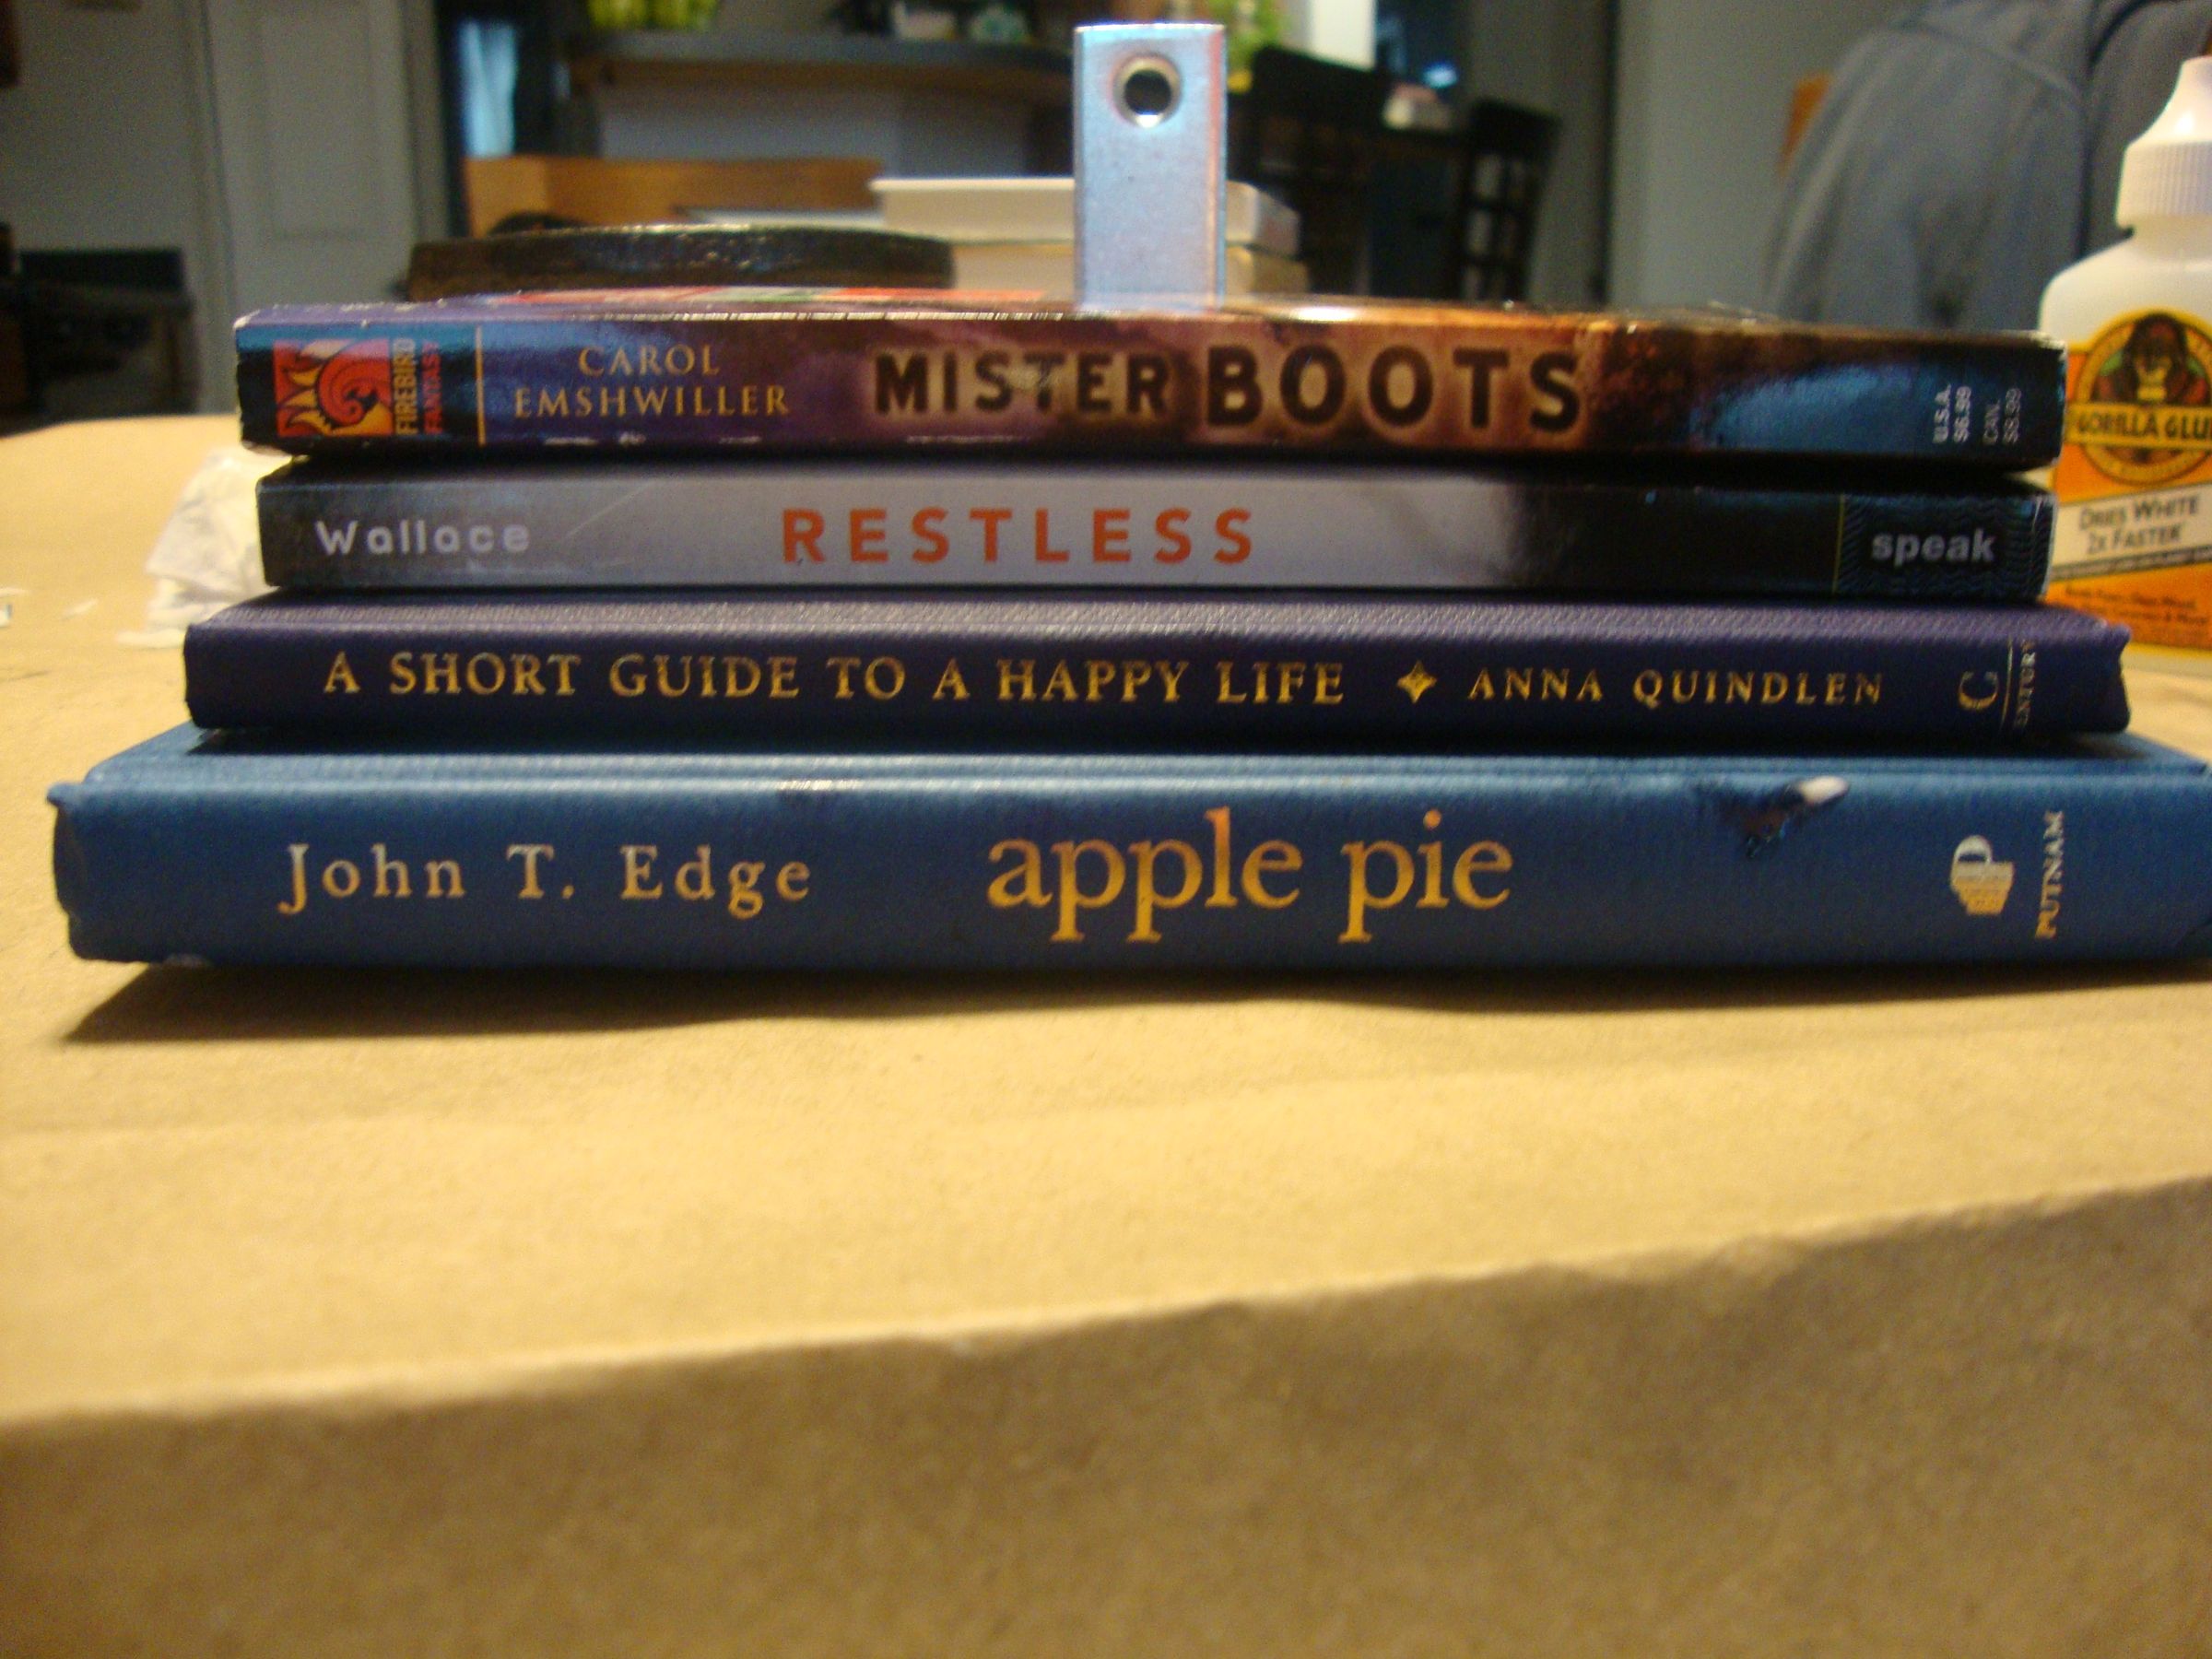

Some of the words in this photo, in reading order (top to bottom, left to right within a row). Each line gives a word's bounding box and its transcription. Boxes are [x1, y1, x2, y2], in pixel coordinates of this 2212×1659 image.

[393, 337, 417, 435] FIREBIRD
[579, 344, 719, 376] CAROL
[513, 385, 790, 418] EMSHWILLER
[875, 351, 1170, 415] MISTER
[1206, 344, 1580, 433] BOOTS
[316, 520, 531, 557] Wallace
[782, 507, 1253, 565] RESTLESS
[1870, 527, 1996, 569] speak
[324, 651, 360, 694] A
[388, 651, 582, 697] SHORT
[607, 653, 801, 700] GUIDE
[826, 655, 907, 700] TO
[931, 658, 971, 701] A
[995, 658, 1191, 704] HAPPY
[1215, 660, 1346, 706] LIFE
[1468, 666, 1604, 701] ANNA
[1632, 667, 1883, 711] QUINDLEN
[277, 842, 465, 916] John
[504, 842, 575, 900] T.
[619, 842, 811, 920] Edge
[986, 805, 1304, 943] apple
[1337, 808, 1515, 945] pie
[2035, 810, 2065, 940] PUTNAM
